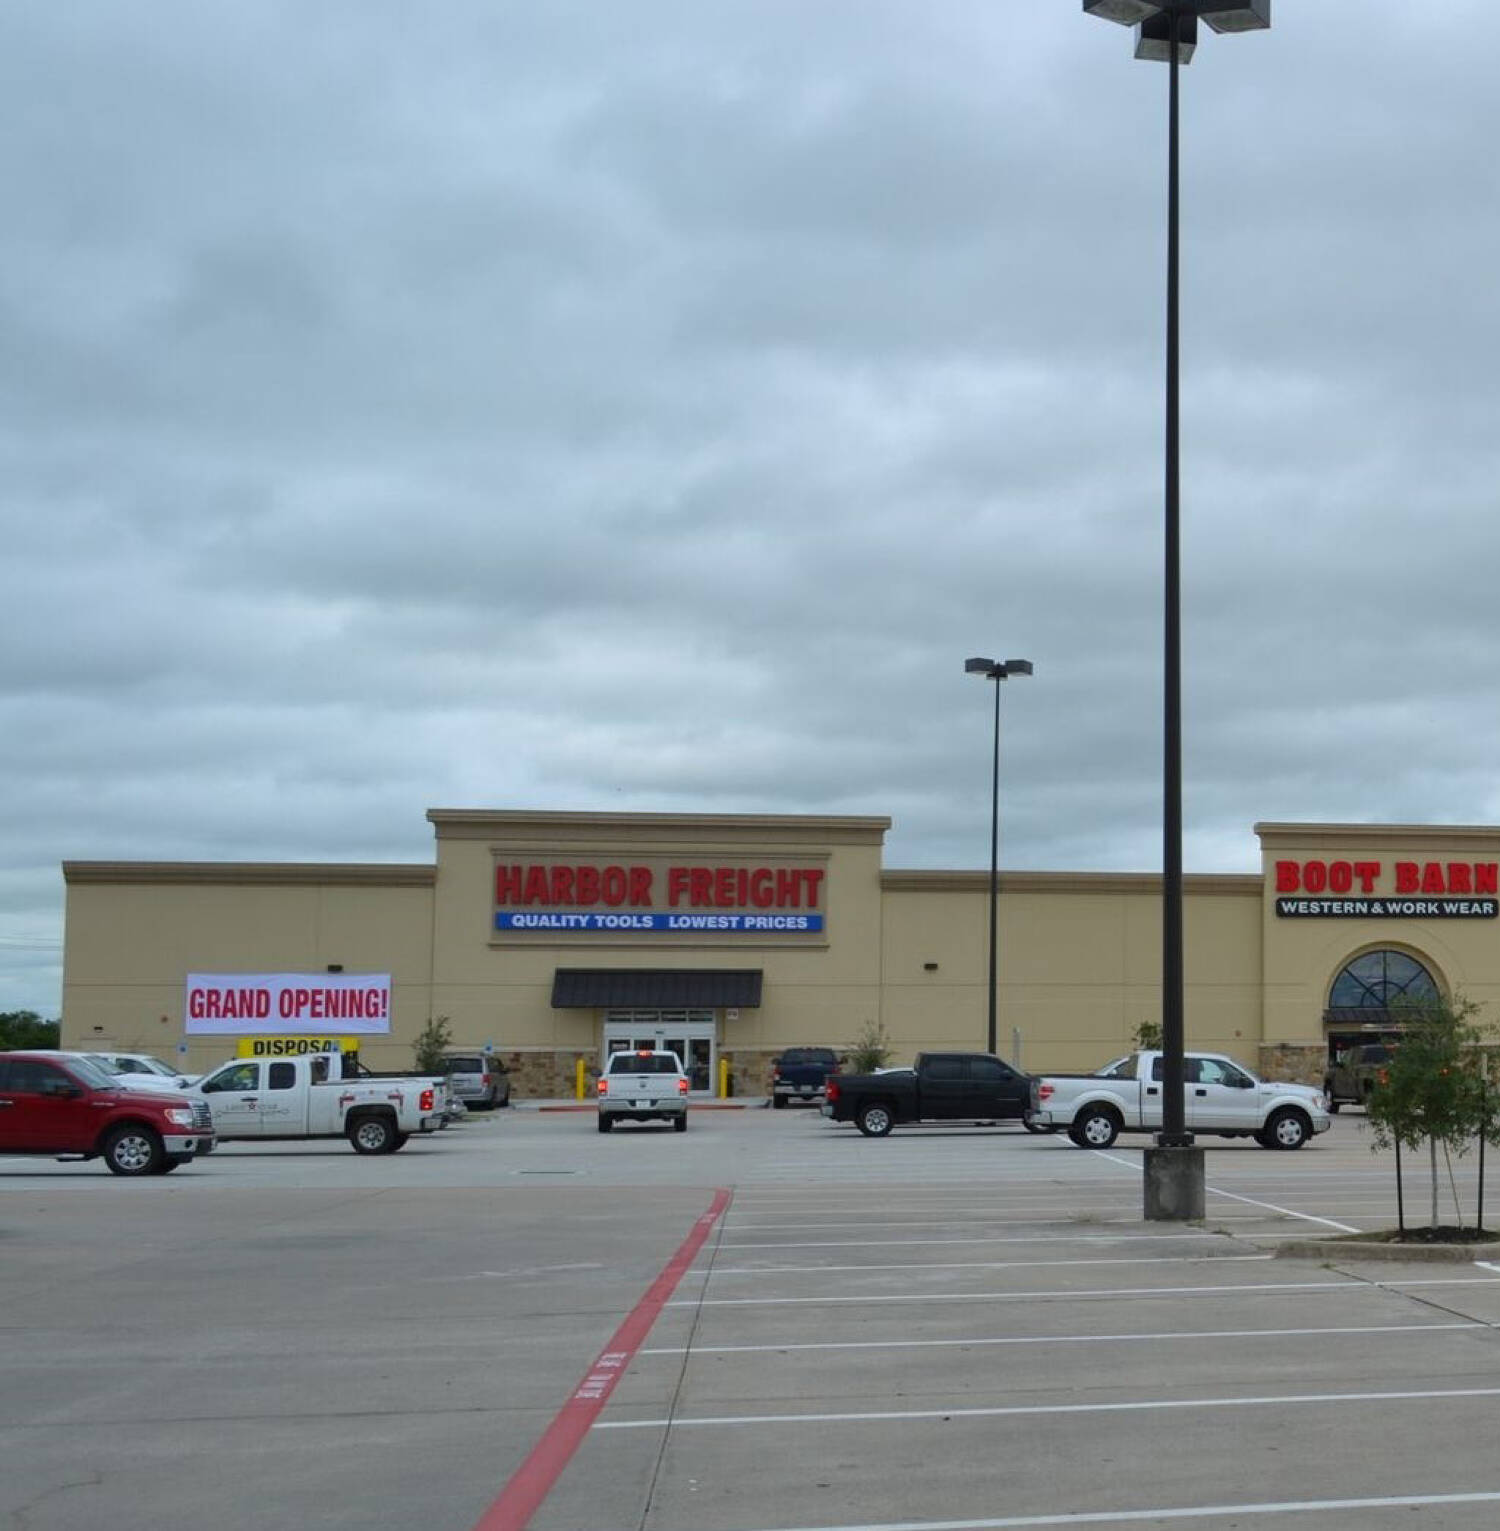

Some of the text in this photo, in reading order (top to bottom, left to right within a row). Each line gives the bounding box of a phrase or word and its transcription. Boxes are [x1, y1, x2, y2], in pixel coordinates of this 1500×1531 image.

[495, 866, 824, 908] HARBOR FREIGHT
[1275, 861, 1499, 894] BOOT BARN
[1281, 901, 1494, 914] WESTERN & WORK WEAR
[511, 915, 808, 929] QUALITY TOOLS LOWEST PRICES
[189, 988, 388, 1019] GRAND OPENING!
[253, 1039, 339, 1056] DISPOSA
